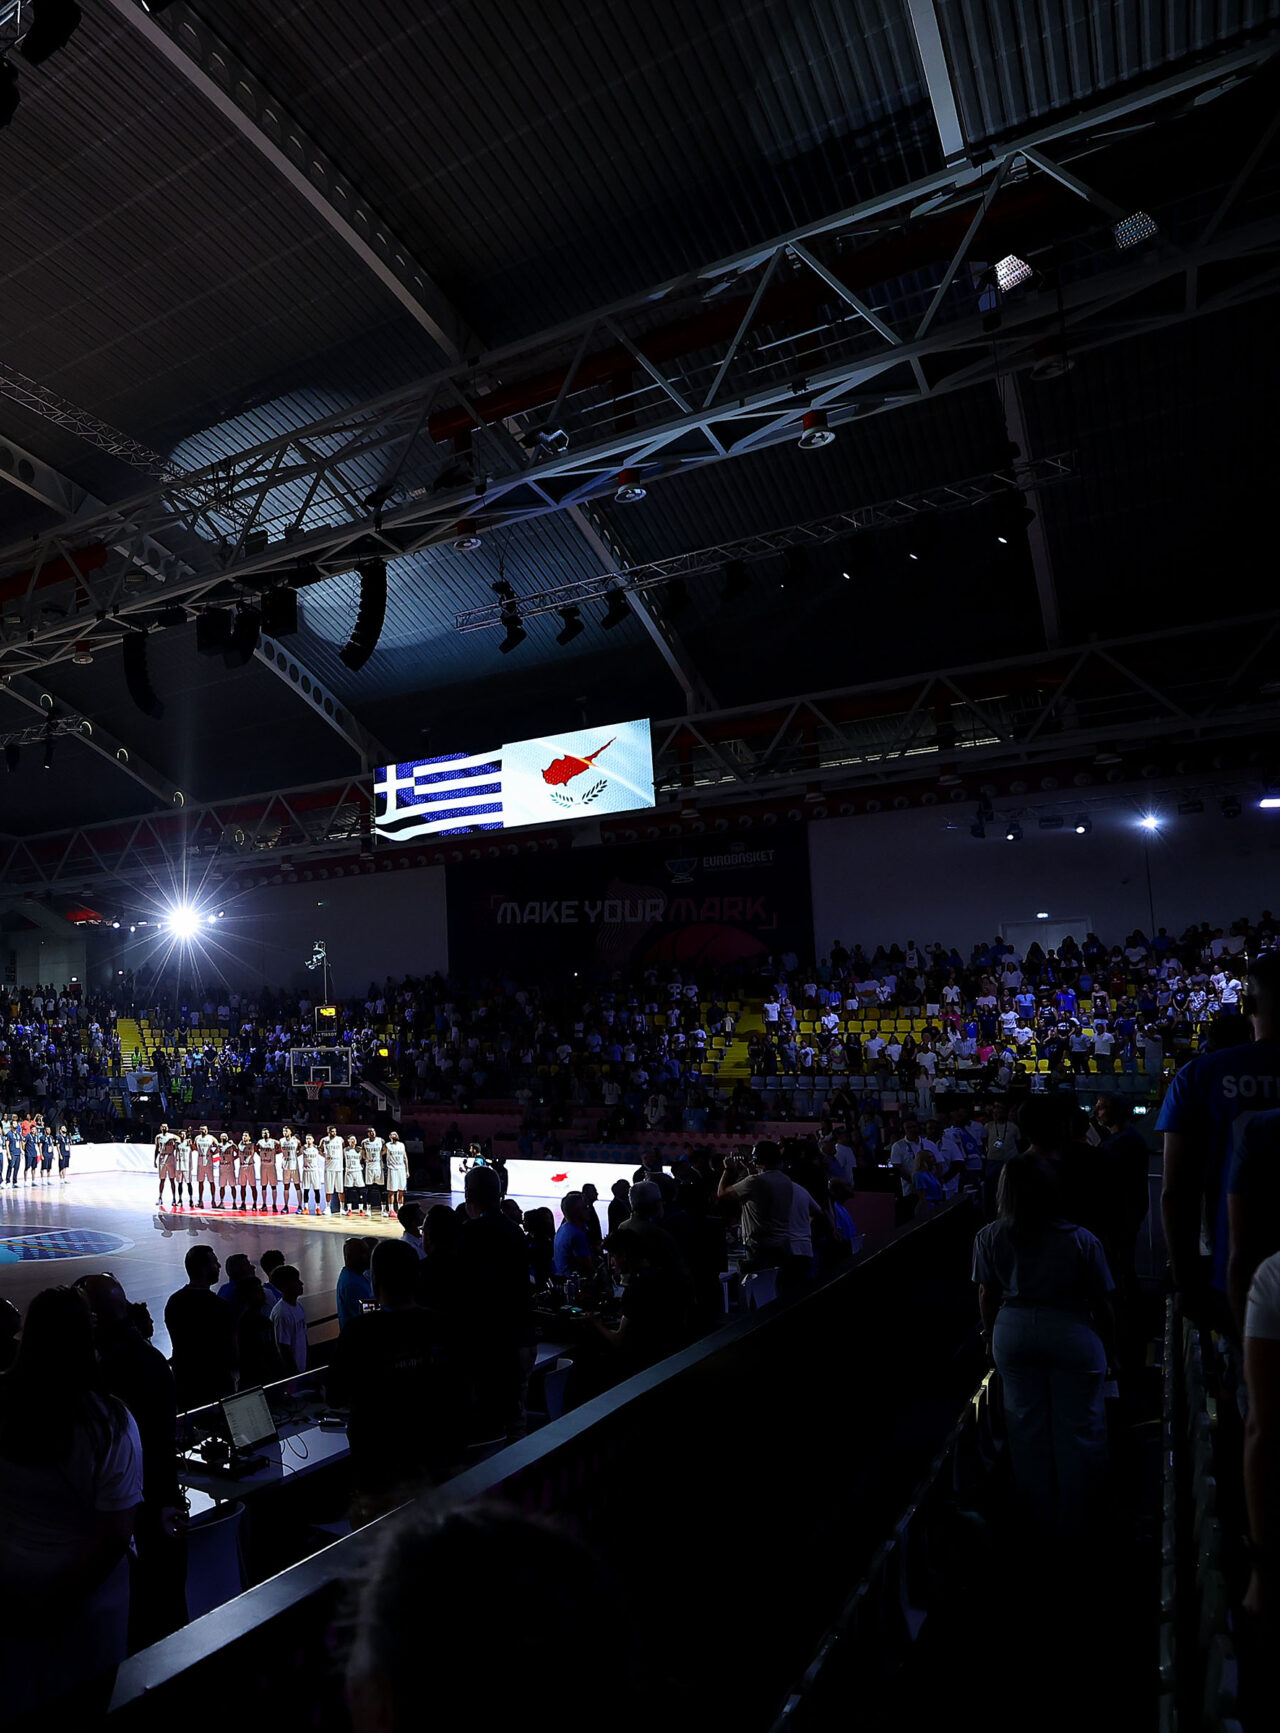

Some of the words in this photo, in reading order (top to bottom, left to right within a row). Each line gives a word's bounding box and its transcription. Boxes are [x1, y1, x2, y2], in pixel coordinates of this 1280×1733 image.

[496, 900, 580, 925] MAKE
[583, 899, 666, 923] YOUR
[669, 896, 768, 922] MARK
[1221, 1074, 1280, 1100] SOT
